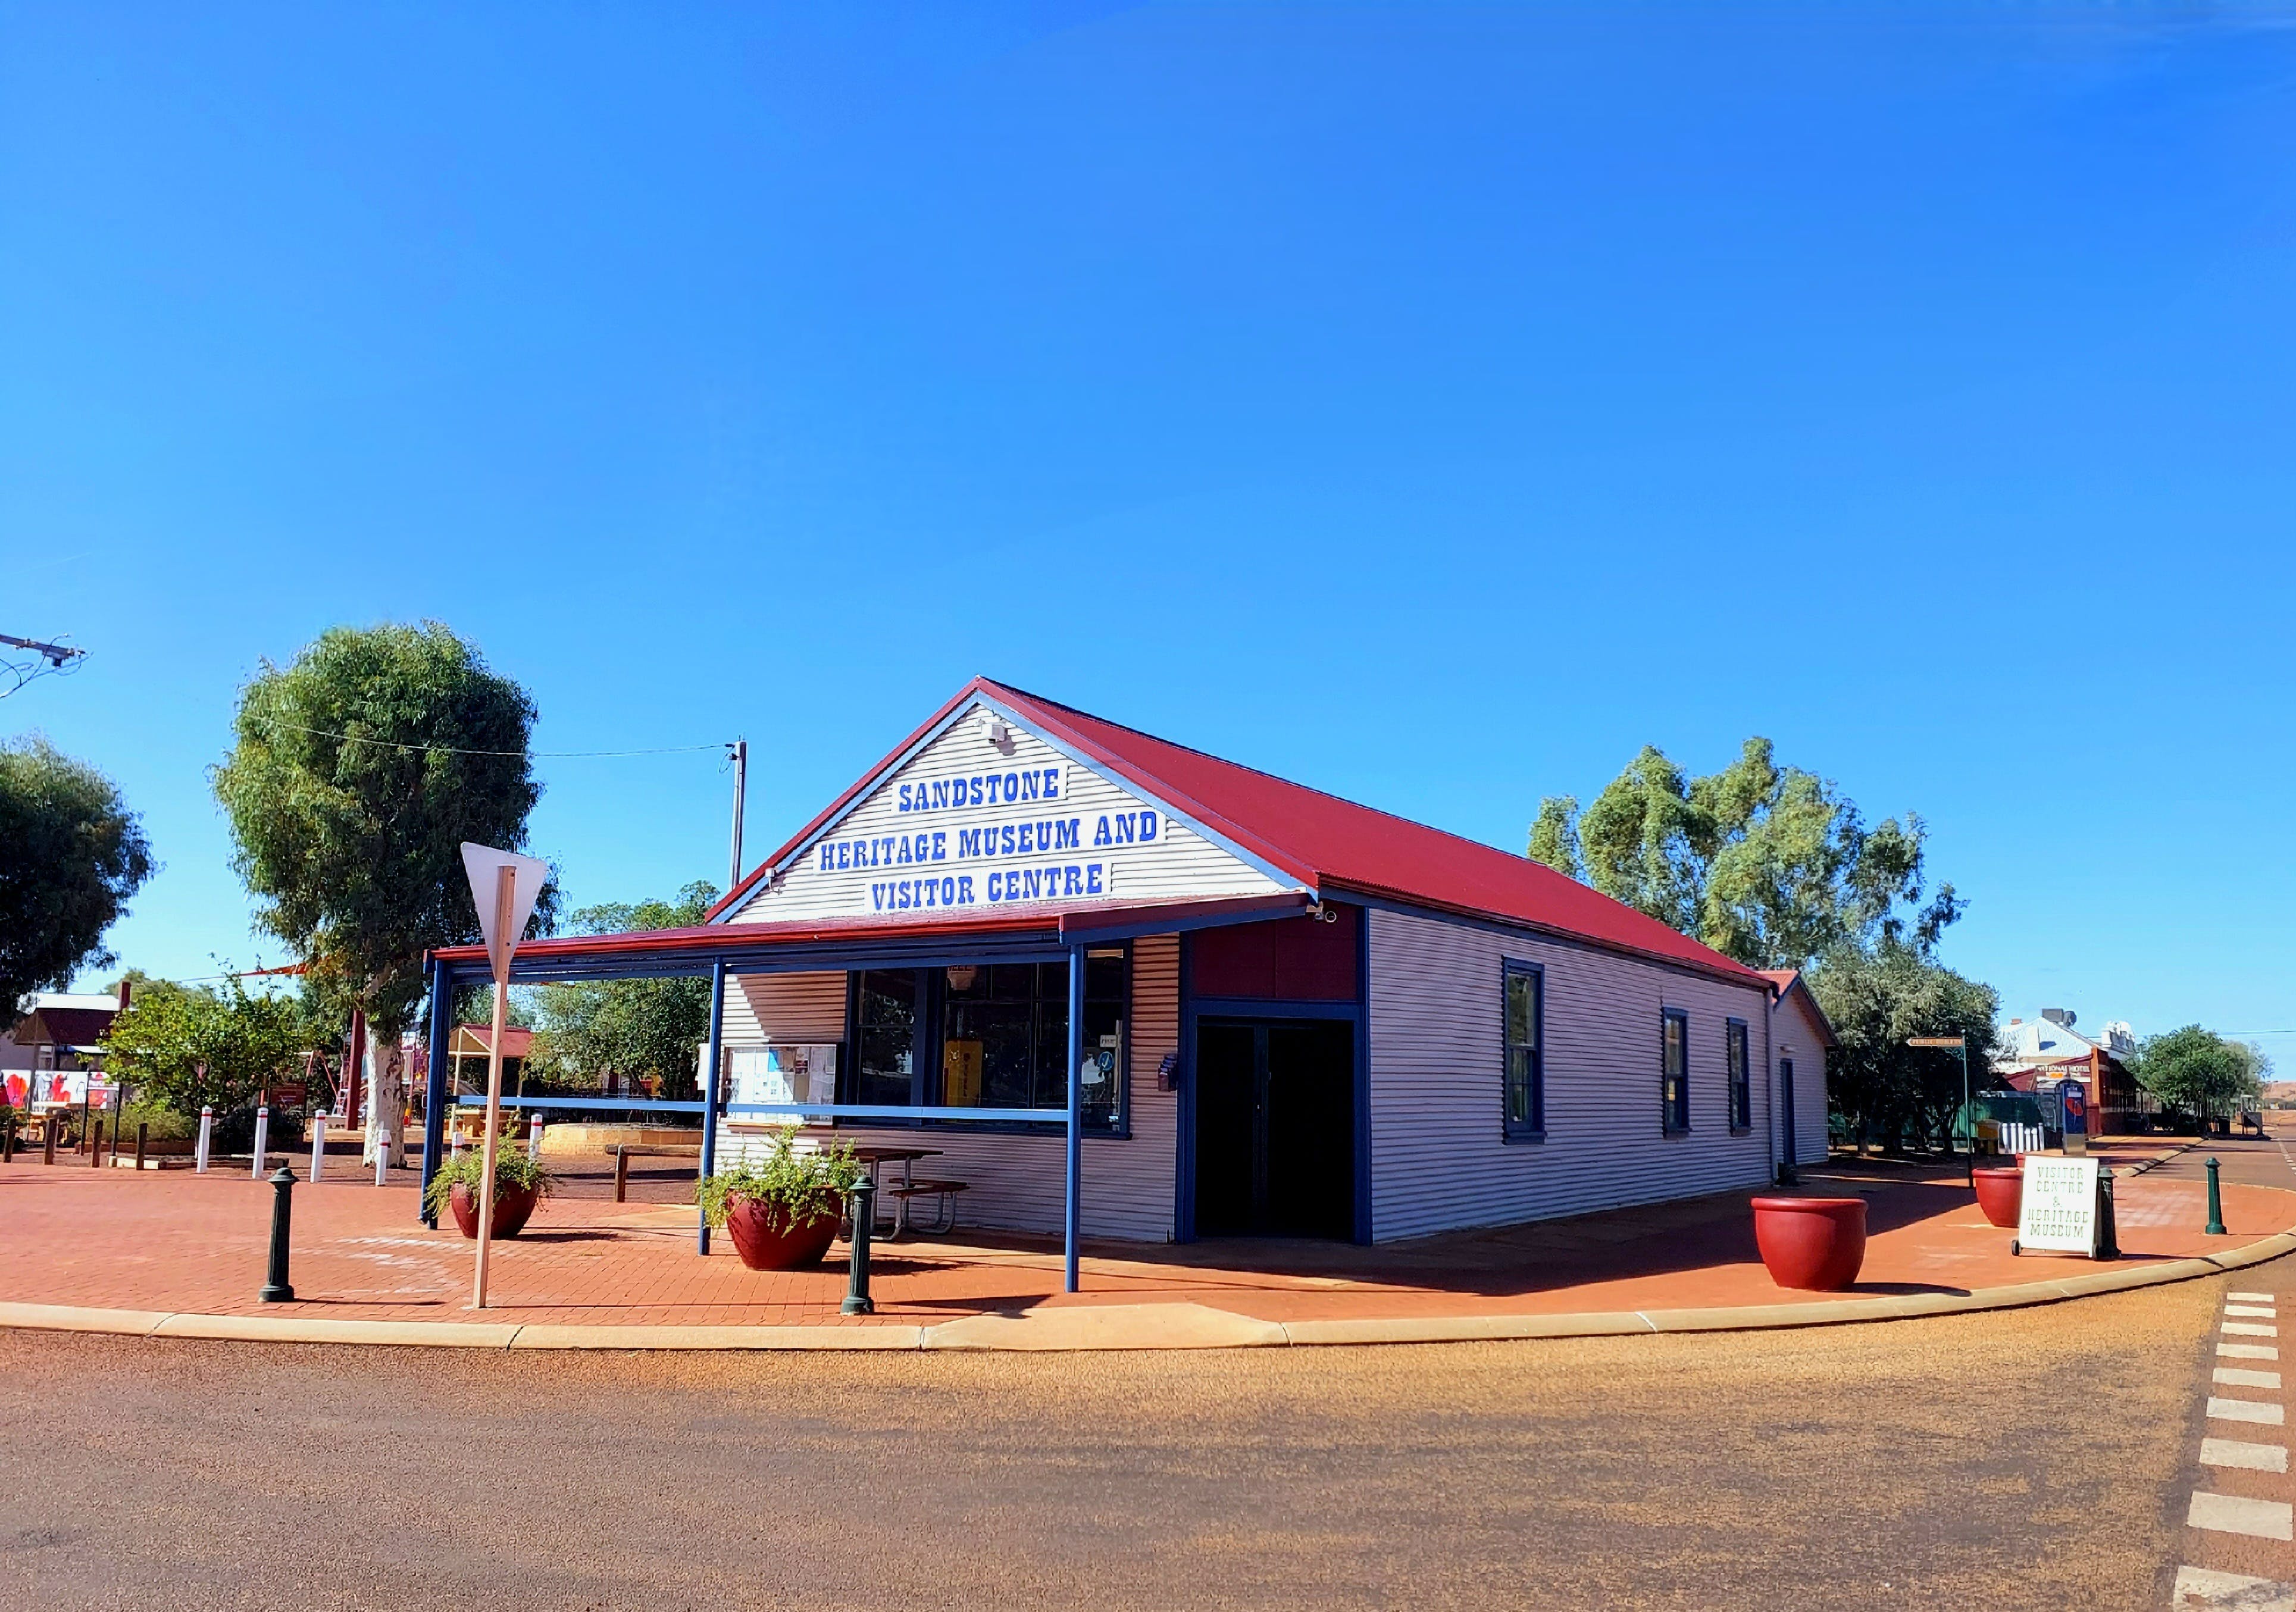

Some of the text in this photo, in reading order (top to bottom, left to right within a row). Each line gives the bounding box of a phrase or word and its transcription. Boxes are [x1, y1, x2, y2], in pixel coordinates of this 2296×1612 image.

[898, 768, 1059, 812] SANDSTONE
[820, 811, 1158, 871] HERITAGE MUSEUM AND
[872, 863, 1103, 911] VISITOR CENTRE
[2037, 1166, 2084, 1179] VISITOR
[2036, 1181, 2084, 1194] CENTRE
[2052, 1196, 2062, 1208] &
[2028, 1209, 2089, 1223] HERITAGE
[2030, 1223, 2084, 1238] MUSEUM
